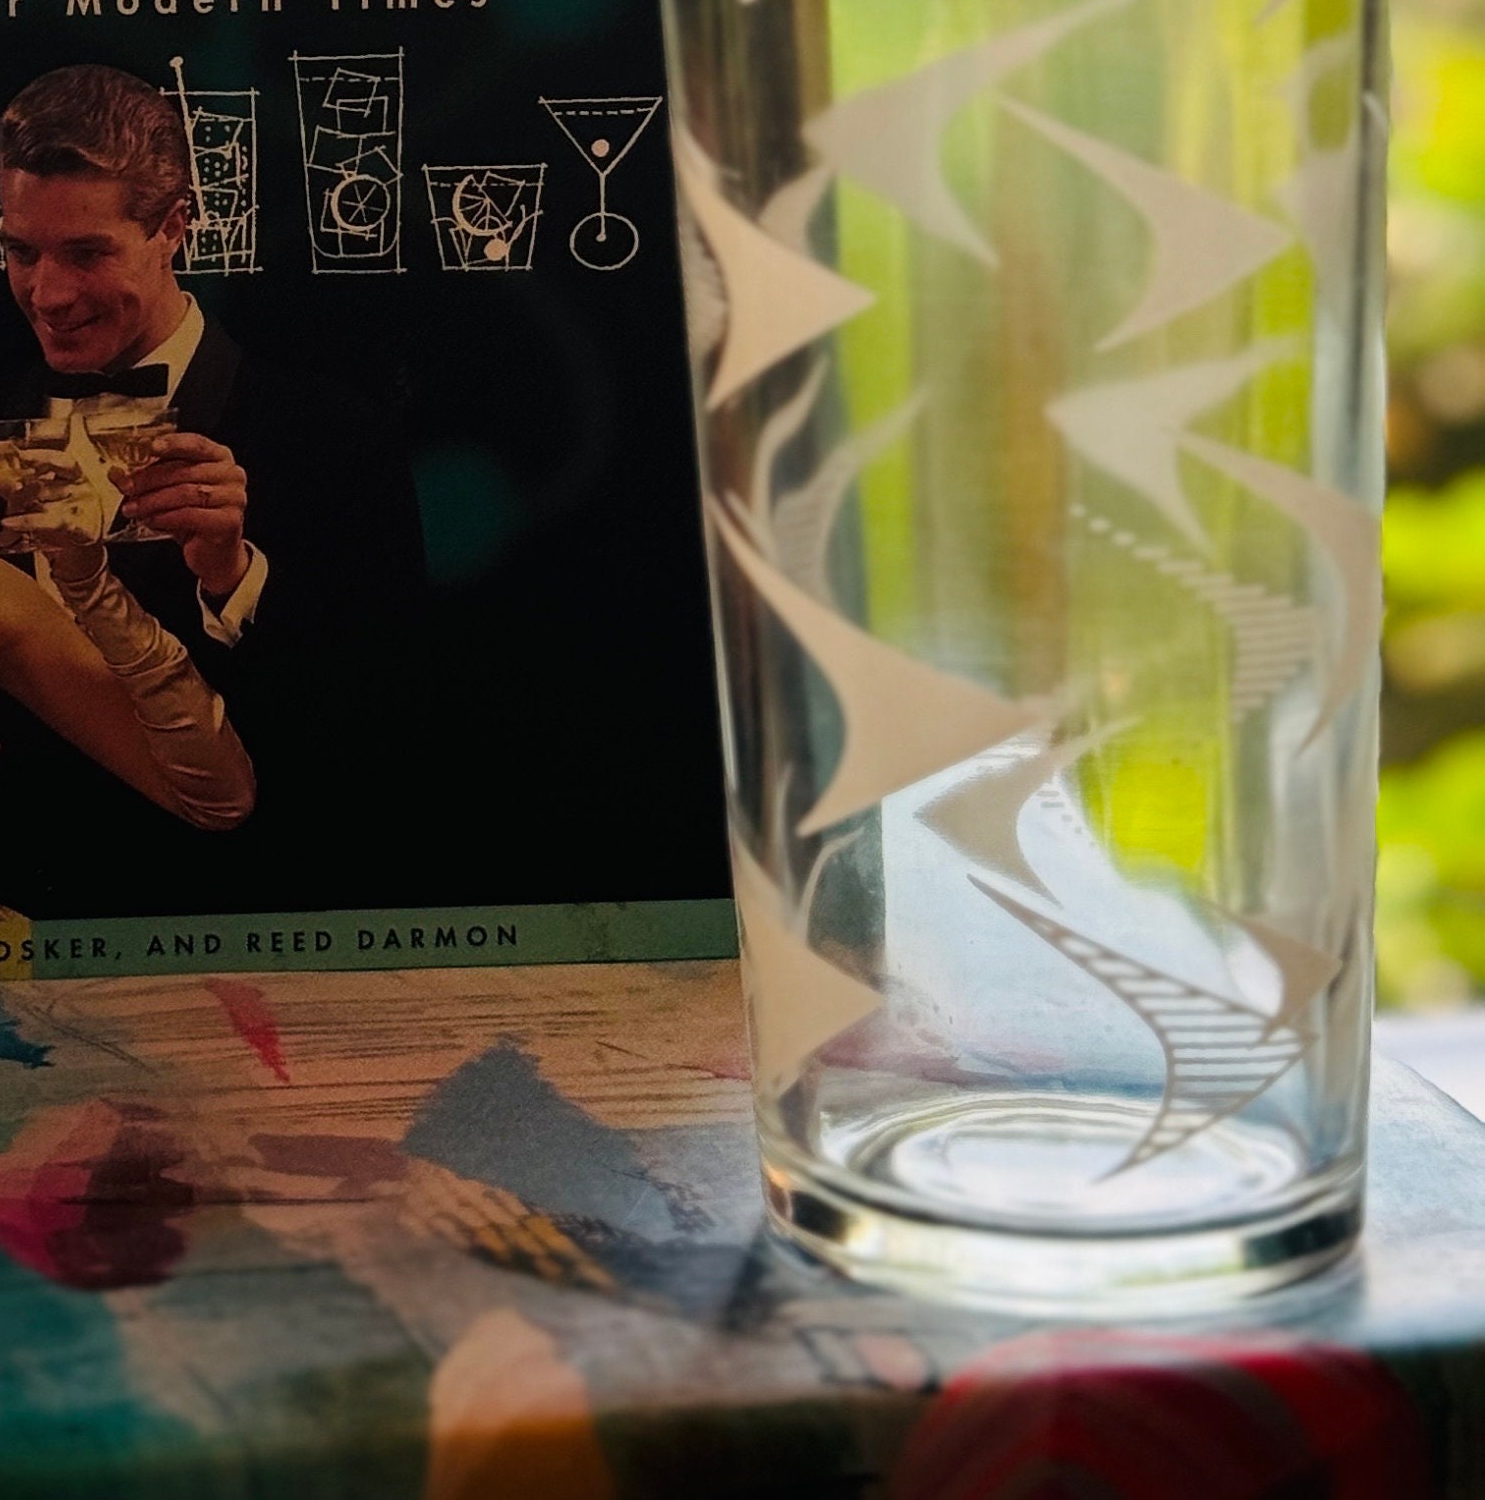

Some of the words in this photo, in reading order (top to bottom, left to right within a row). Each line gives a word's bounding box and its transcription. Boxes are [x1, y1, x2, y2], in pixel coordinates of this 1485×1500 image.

[146, 933, 222, 956] AND
[246, 930, 333, 952] REED
[358, 924, 518, 951] DARMON
